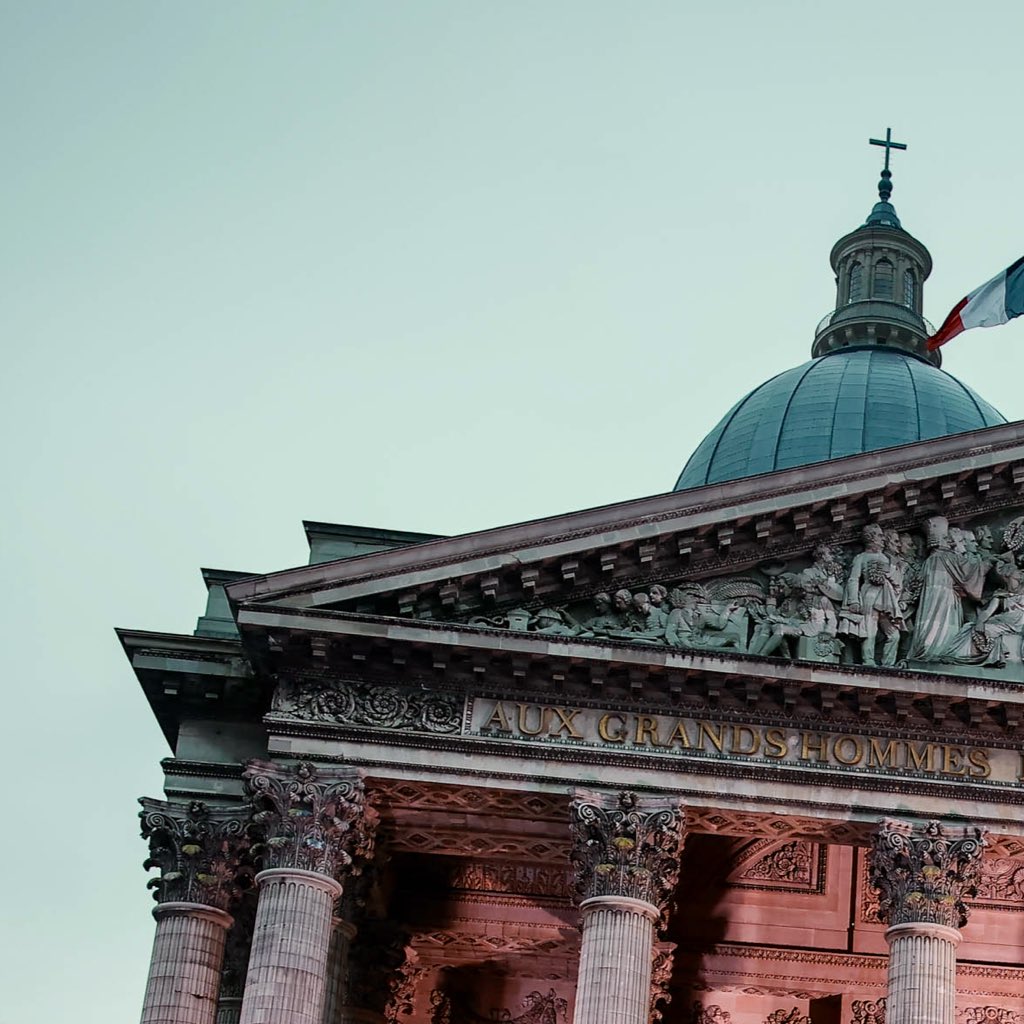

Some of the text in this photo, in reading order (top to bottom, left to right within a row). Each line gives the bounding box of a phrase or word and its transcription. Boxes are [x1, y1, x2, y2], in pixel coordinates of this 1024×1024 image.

[480, 702, 584, 739] AUX
[598, 712, 788, 758] GRANDS
[799, 733, 992, 779] HOMMES
